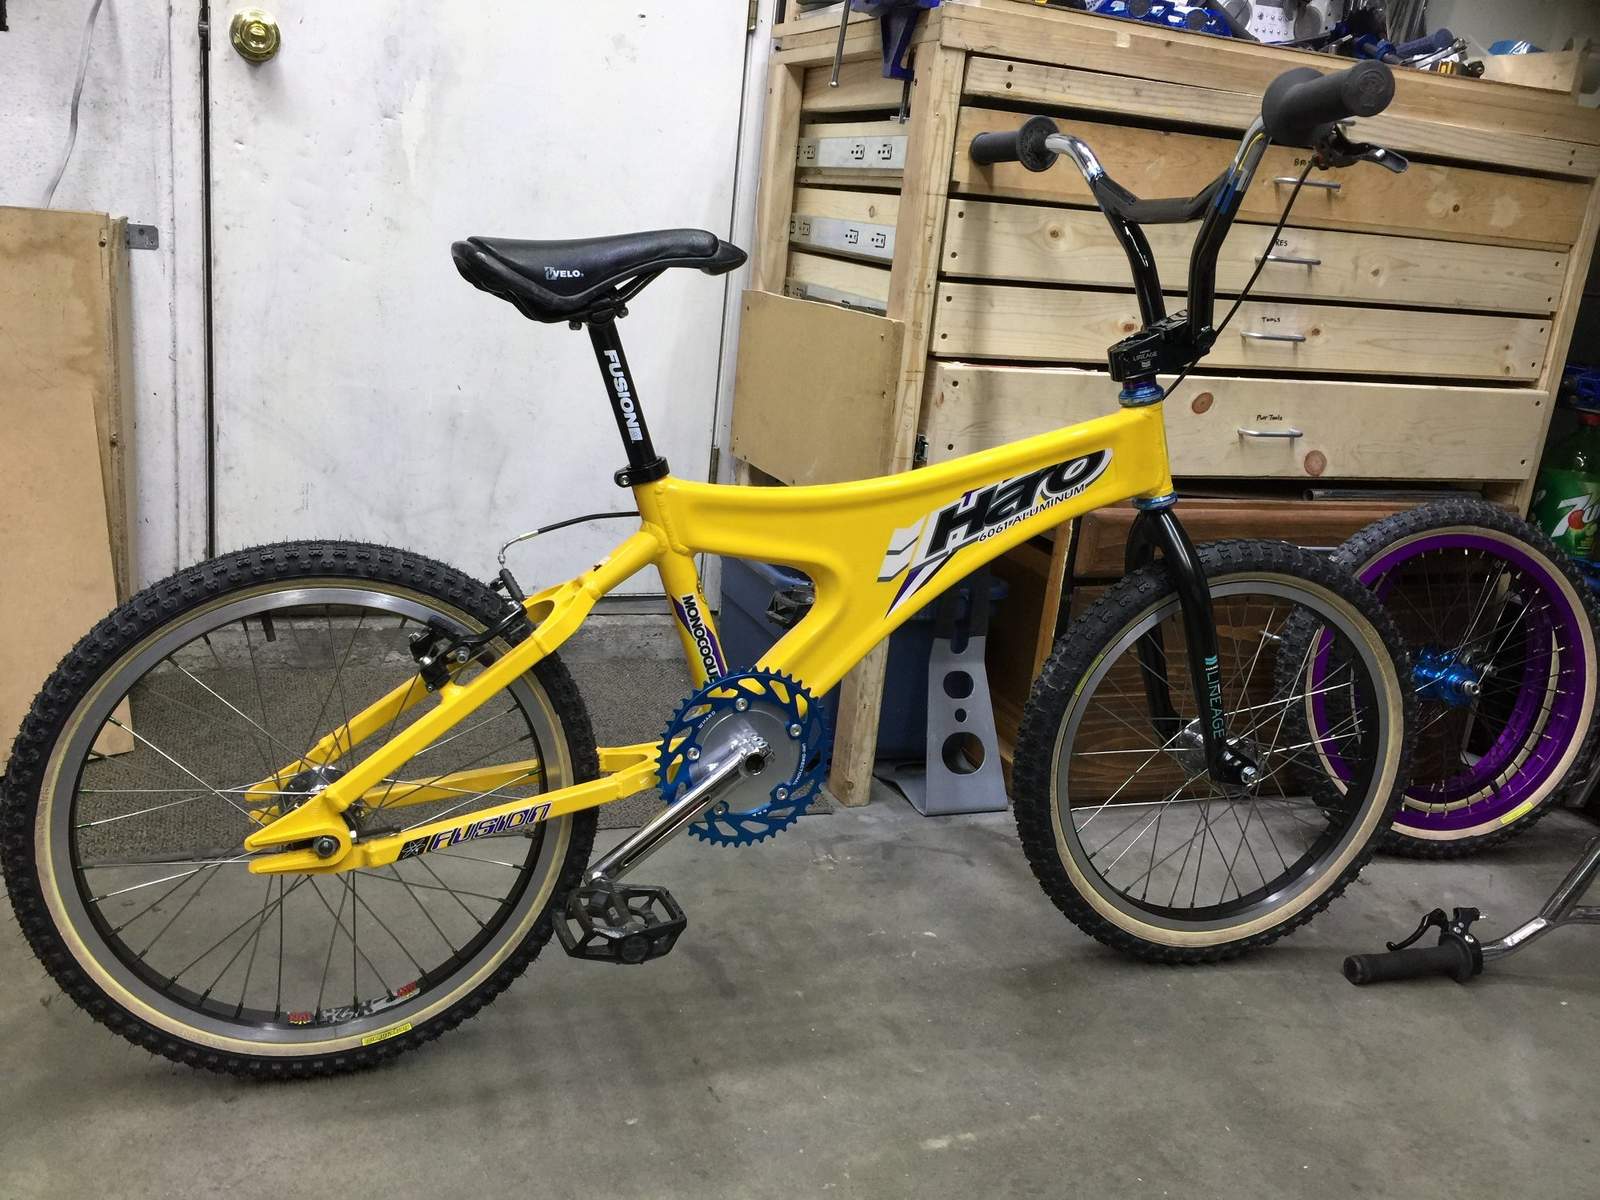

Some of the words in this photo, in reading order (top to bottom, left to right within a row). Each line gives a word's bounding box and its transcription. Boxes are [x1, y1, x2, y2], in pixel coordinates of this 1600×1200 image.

[603, 349, 641, 429] FUSION
[924, 448, 1113, 560] Haro
[1207, 670, 1225, 740] LINEAGE
